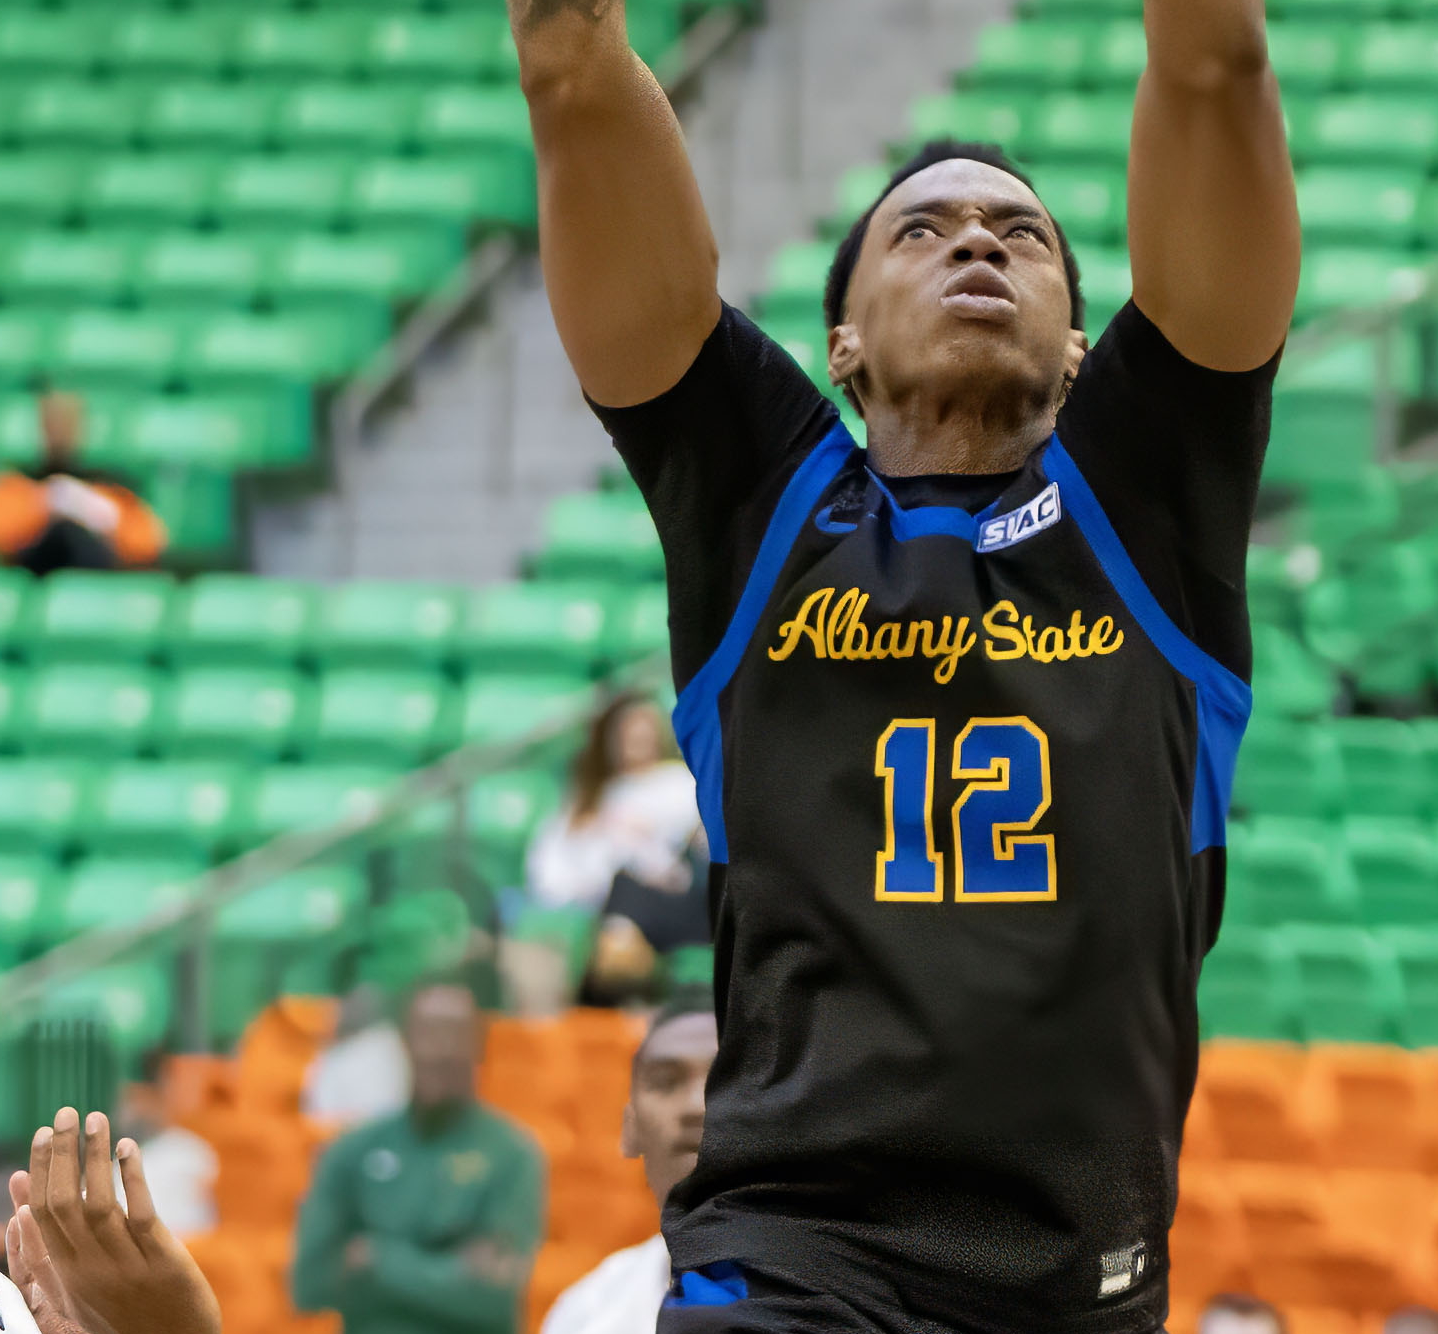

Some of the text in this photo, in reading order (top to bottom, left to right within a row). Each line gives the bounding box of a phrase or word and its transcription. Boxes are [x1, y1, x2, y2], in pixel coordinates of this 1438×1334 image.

[981, 491, 1056, 547] SIAC
[768, 587, 1124, 684] Albany State
[874, 715, 1057, 902] 12
